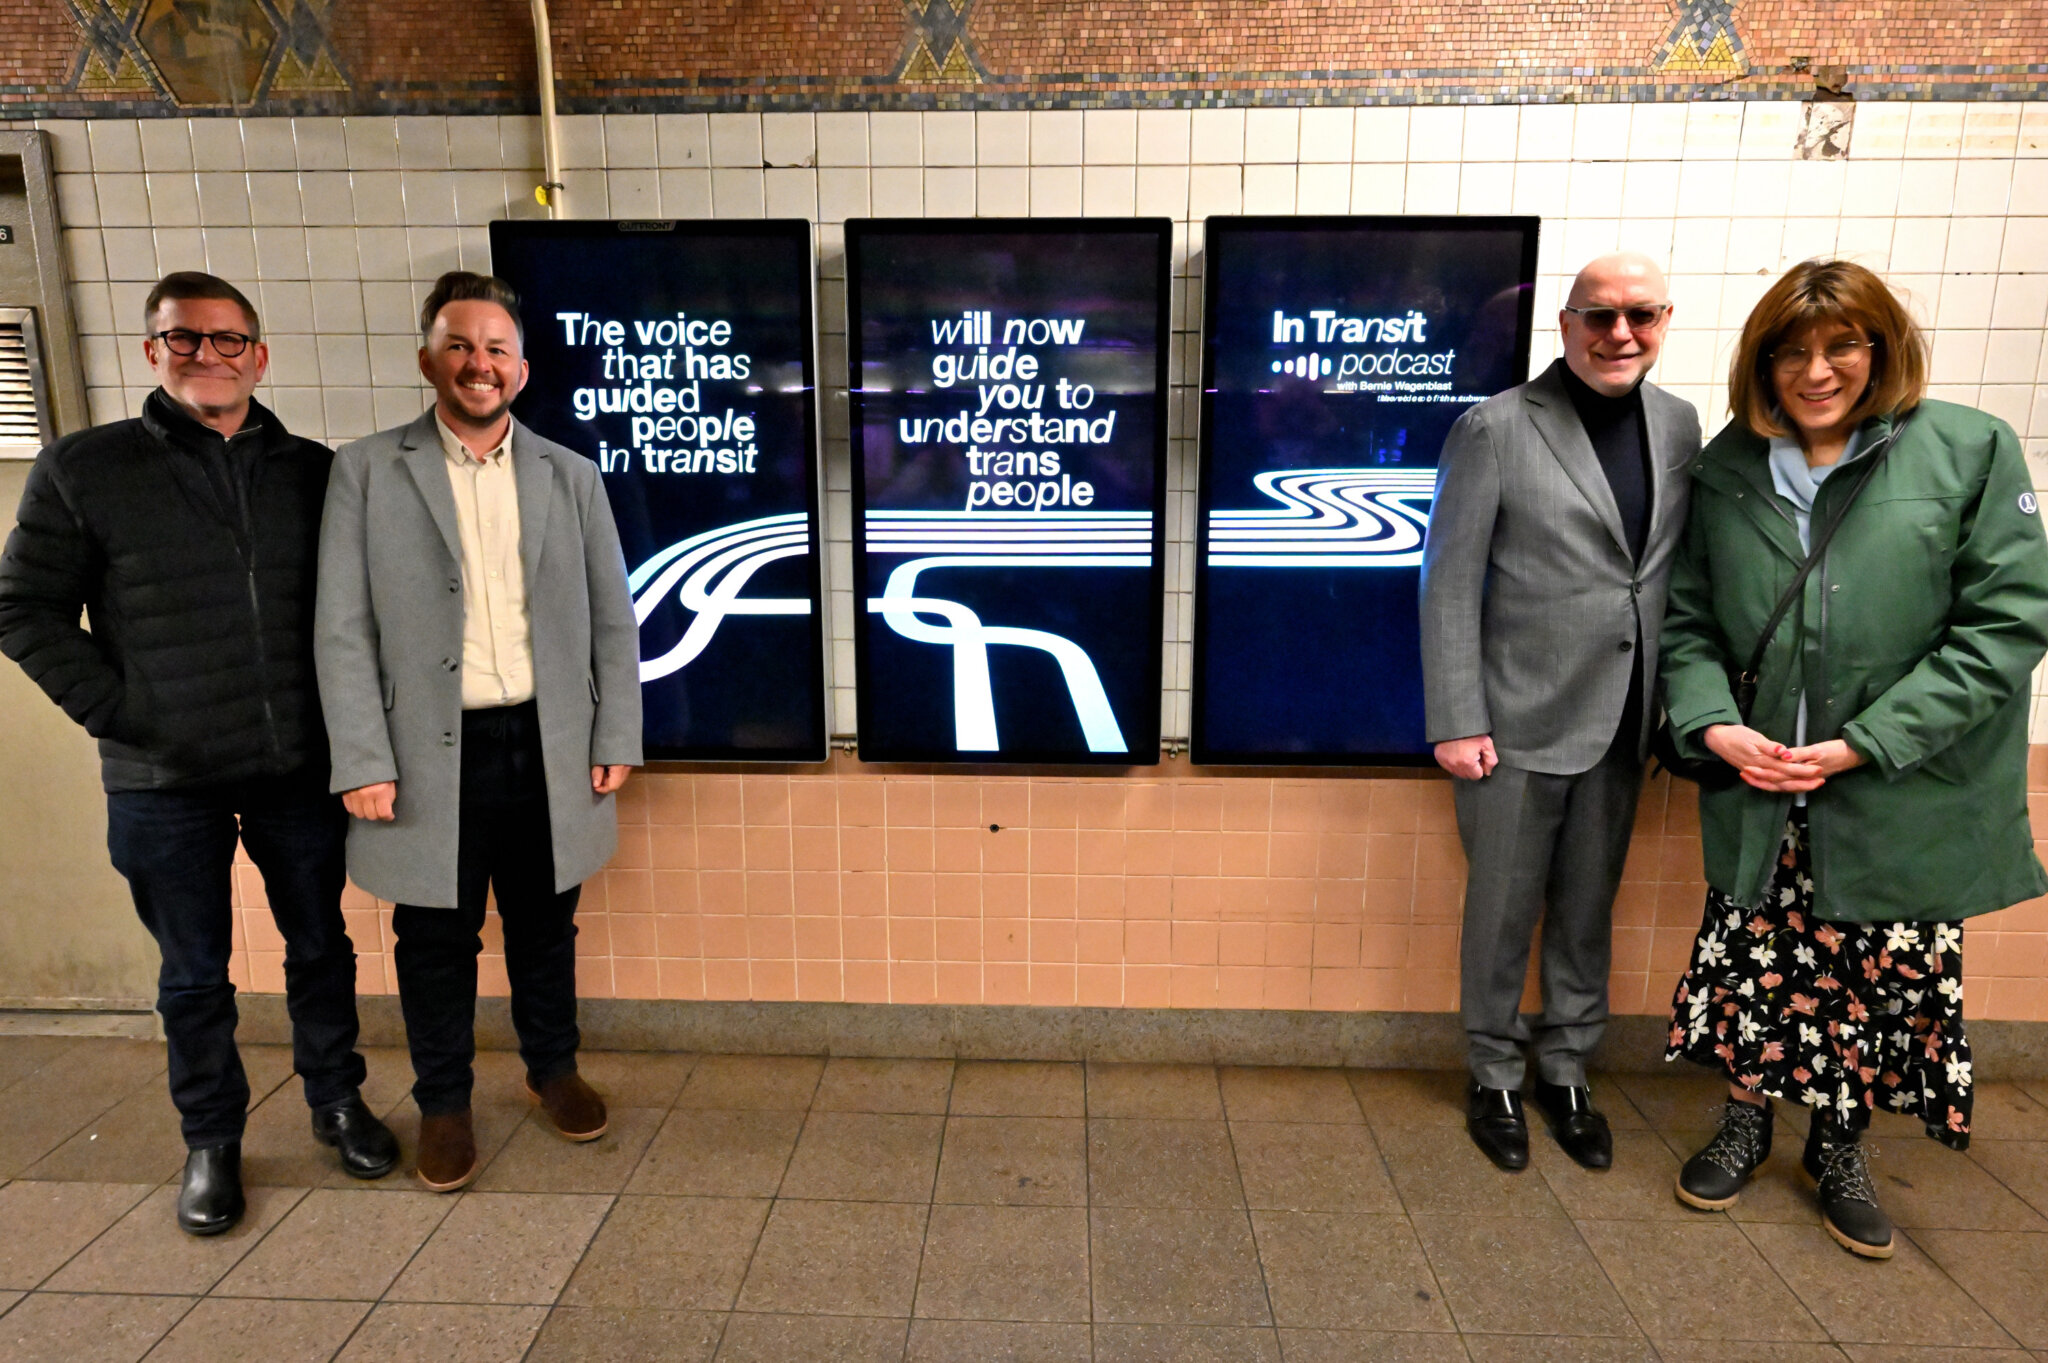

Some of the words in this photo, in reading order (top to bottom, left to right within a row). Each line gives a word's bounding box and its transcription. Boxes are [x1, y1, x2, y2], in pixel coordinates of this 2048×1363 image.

[557, 313, 625, 346] The
[634, 312, 732, 346] voice
[932, 311, 991, 345] will
[1003, 319, 1085, 345] now
[1273, 310, 1304, 343] In
[1310, 310, 1427, 343] Transit
[602, 348, 676, 380] that
[686, 346, 751, 380] has
[932, 347, 1039, 388] guide
[1337, 348, 1455, 380] podcast
[573, 379, 700, 421] guided
[975, 383, 1046, 417] you
[1056, 377, 1095, 410] to
[1336, 380, 1358, 391] with
[1359, 380, 1393, 391] Bernie
[1393, 380, 1453, 393] Wagenblast
[632, 408, 756, 448] people
[899, 410, 1116, 444] understand
[600, 441, 630, 473] in
[641, 442, 759, 474] transit
[965, 445, 1060, 476] trans
[965, 474, 1095, 512] people
